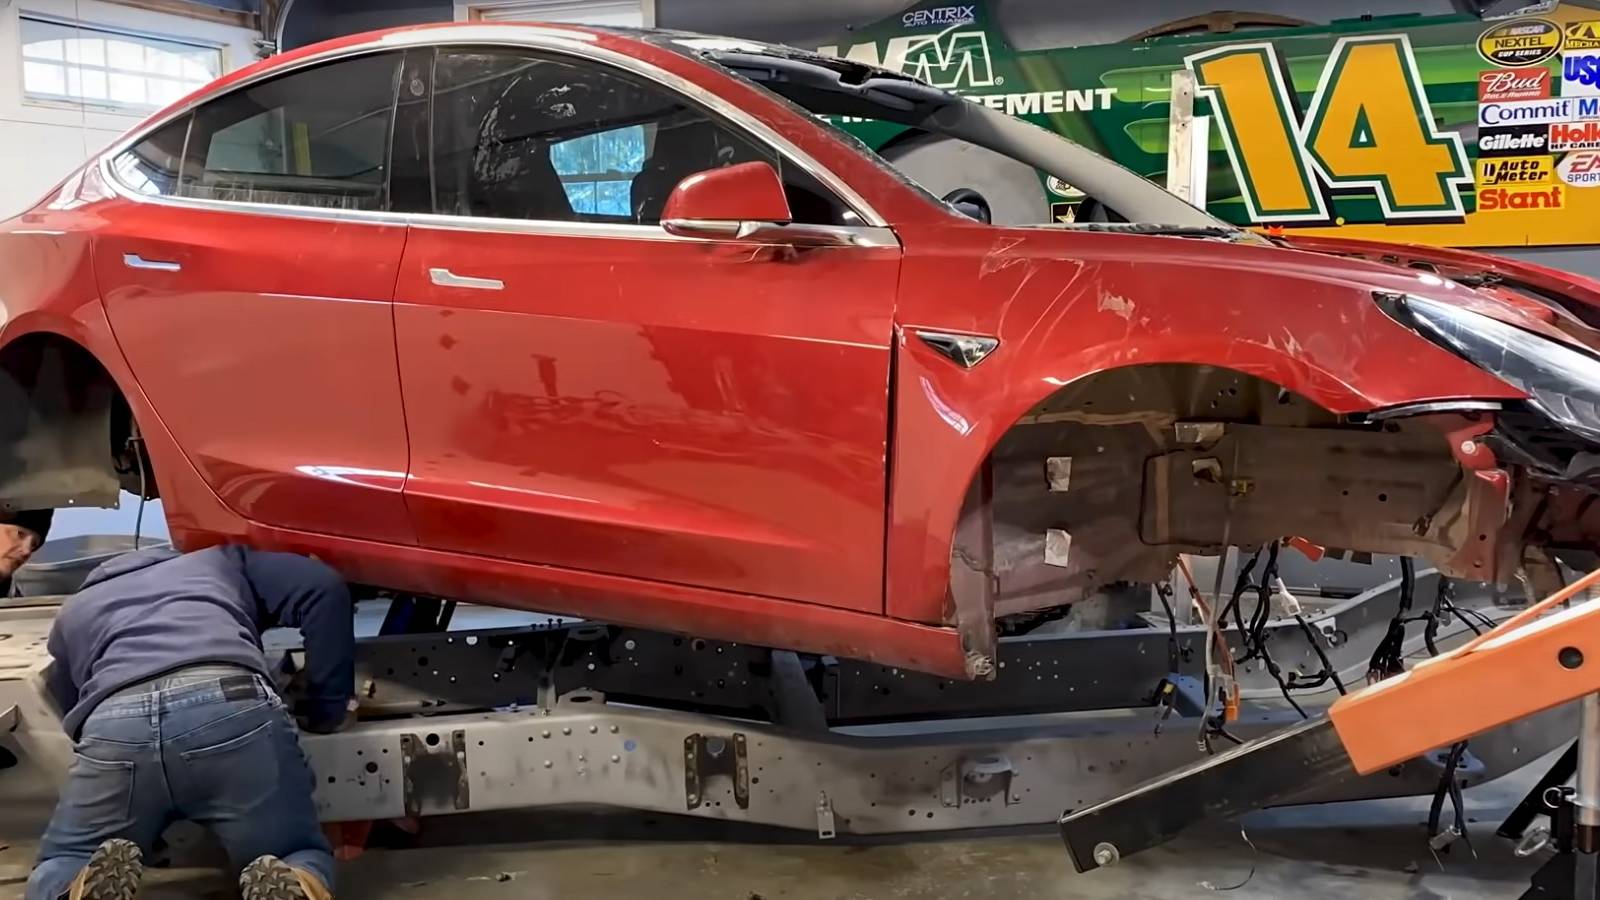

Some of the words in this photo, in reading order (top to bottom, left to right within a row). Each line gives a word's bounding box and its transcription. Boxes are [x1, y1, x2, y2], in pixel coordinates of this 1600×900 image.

[902, 5, 975, 23] CENTRIX
[1494, 37, 1545, 49] NEXTEL
[1565, 39, 1600, 49] MECHA
[1498, 50, 1514, 58] CUP
[1515, 48, 1542, 56] SERIES
[1481, 71, 1548, 92] Bud
[963, 87, 1118, 116] EMENT
[1578, 98, 1600, 116] M
[1481, 102, 1568, 125] Commit
[1186, 35, 1474, 222] 14
[1551, 123, 1600, 144] Holl
[1479, 134, 1545, 150] Gillette
[1499, 159, 1540, 171] Auto
[1494, 170, 1548, 184] Meter
[1479, 186, 1562, 210] Stant
